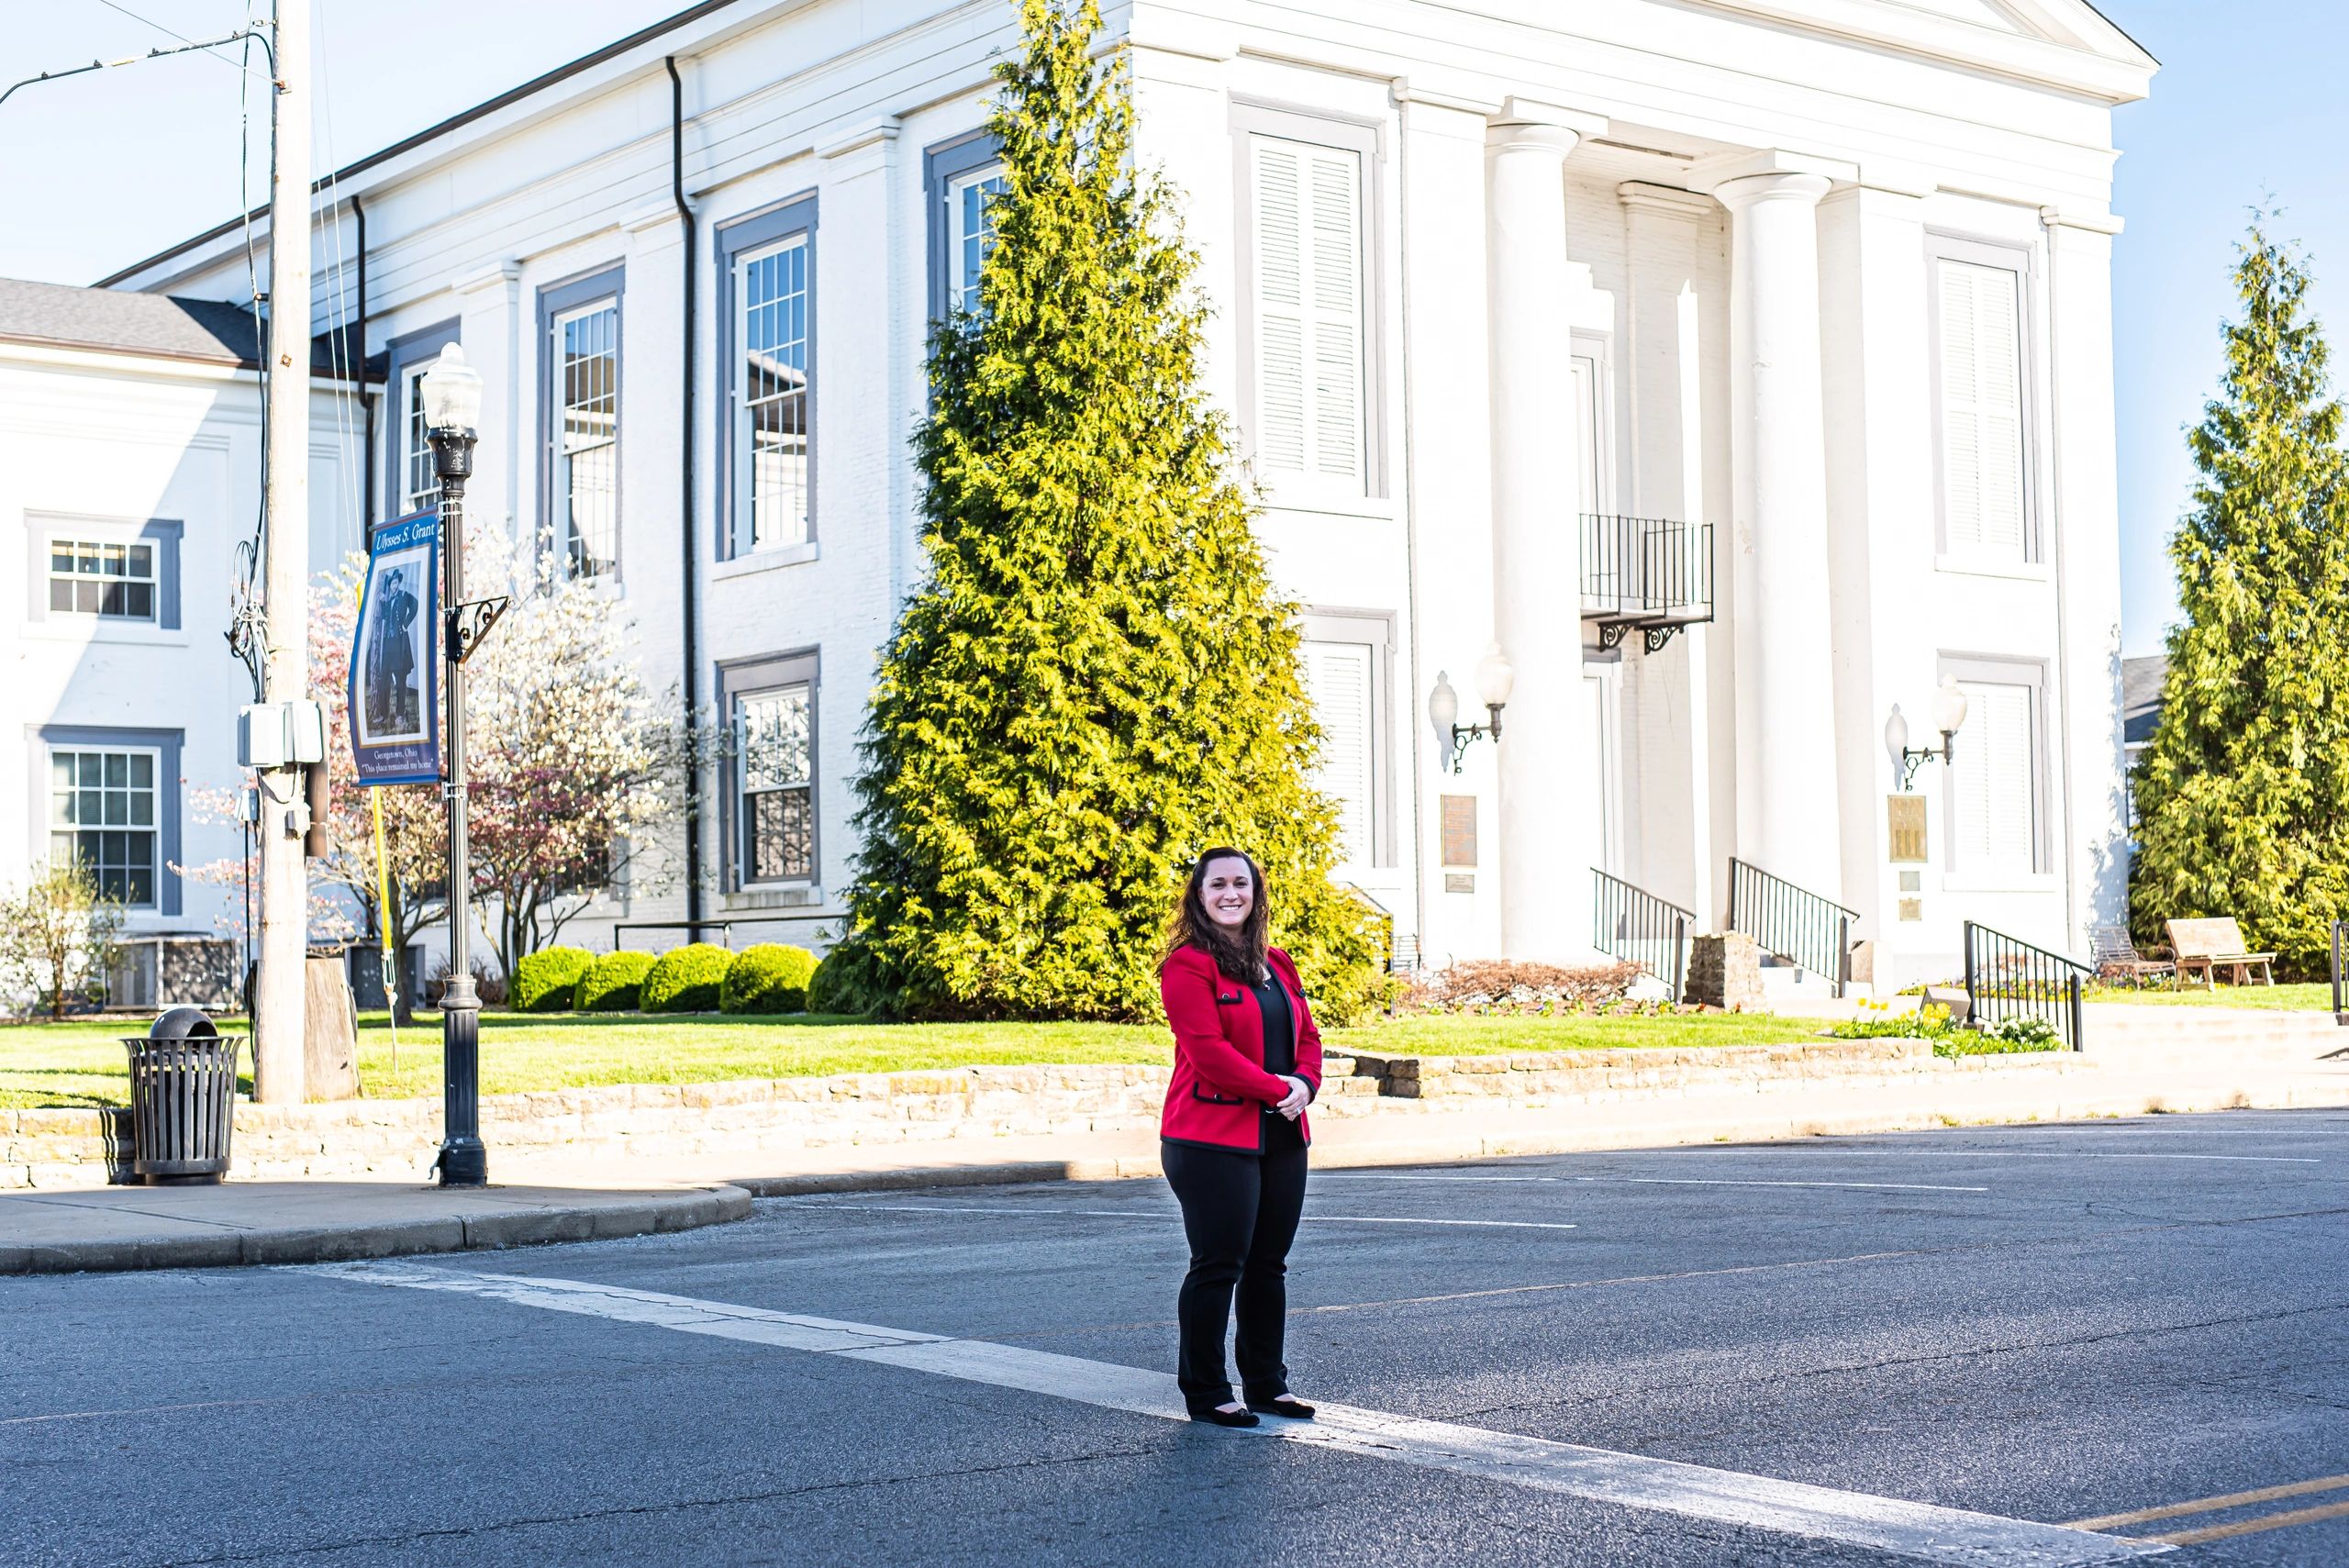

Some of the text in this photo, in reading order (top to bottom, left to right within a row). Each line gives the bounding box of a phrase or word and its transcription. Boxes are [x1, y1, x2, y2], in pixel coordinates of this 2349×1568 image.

[376, 523, 435, 550] Ulysses S. Grant
[374, 748, 417, 760] Georgetown, Ohio
[375, 762, 387, 774] place
[388, 761, 409, 771] remained
